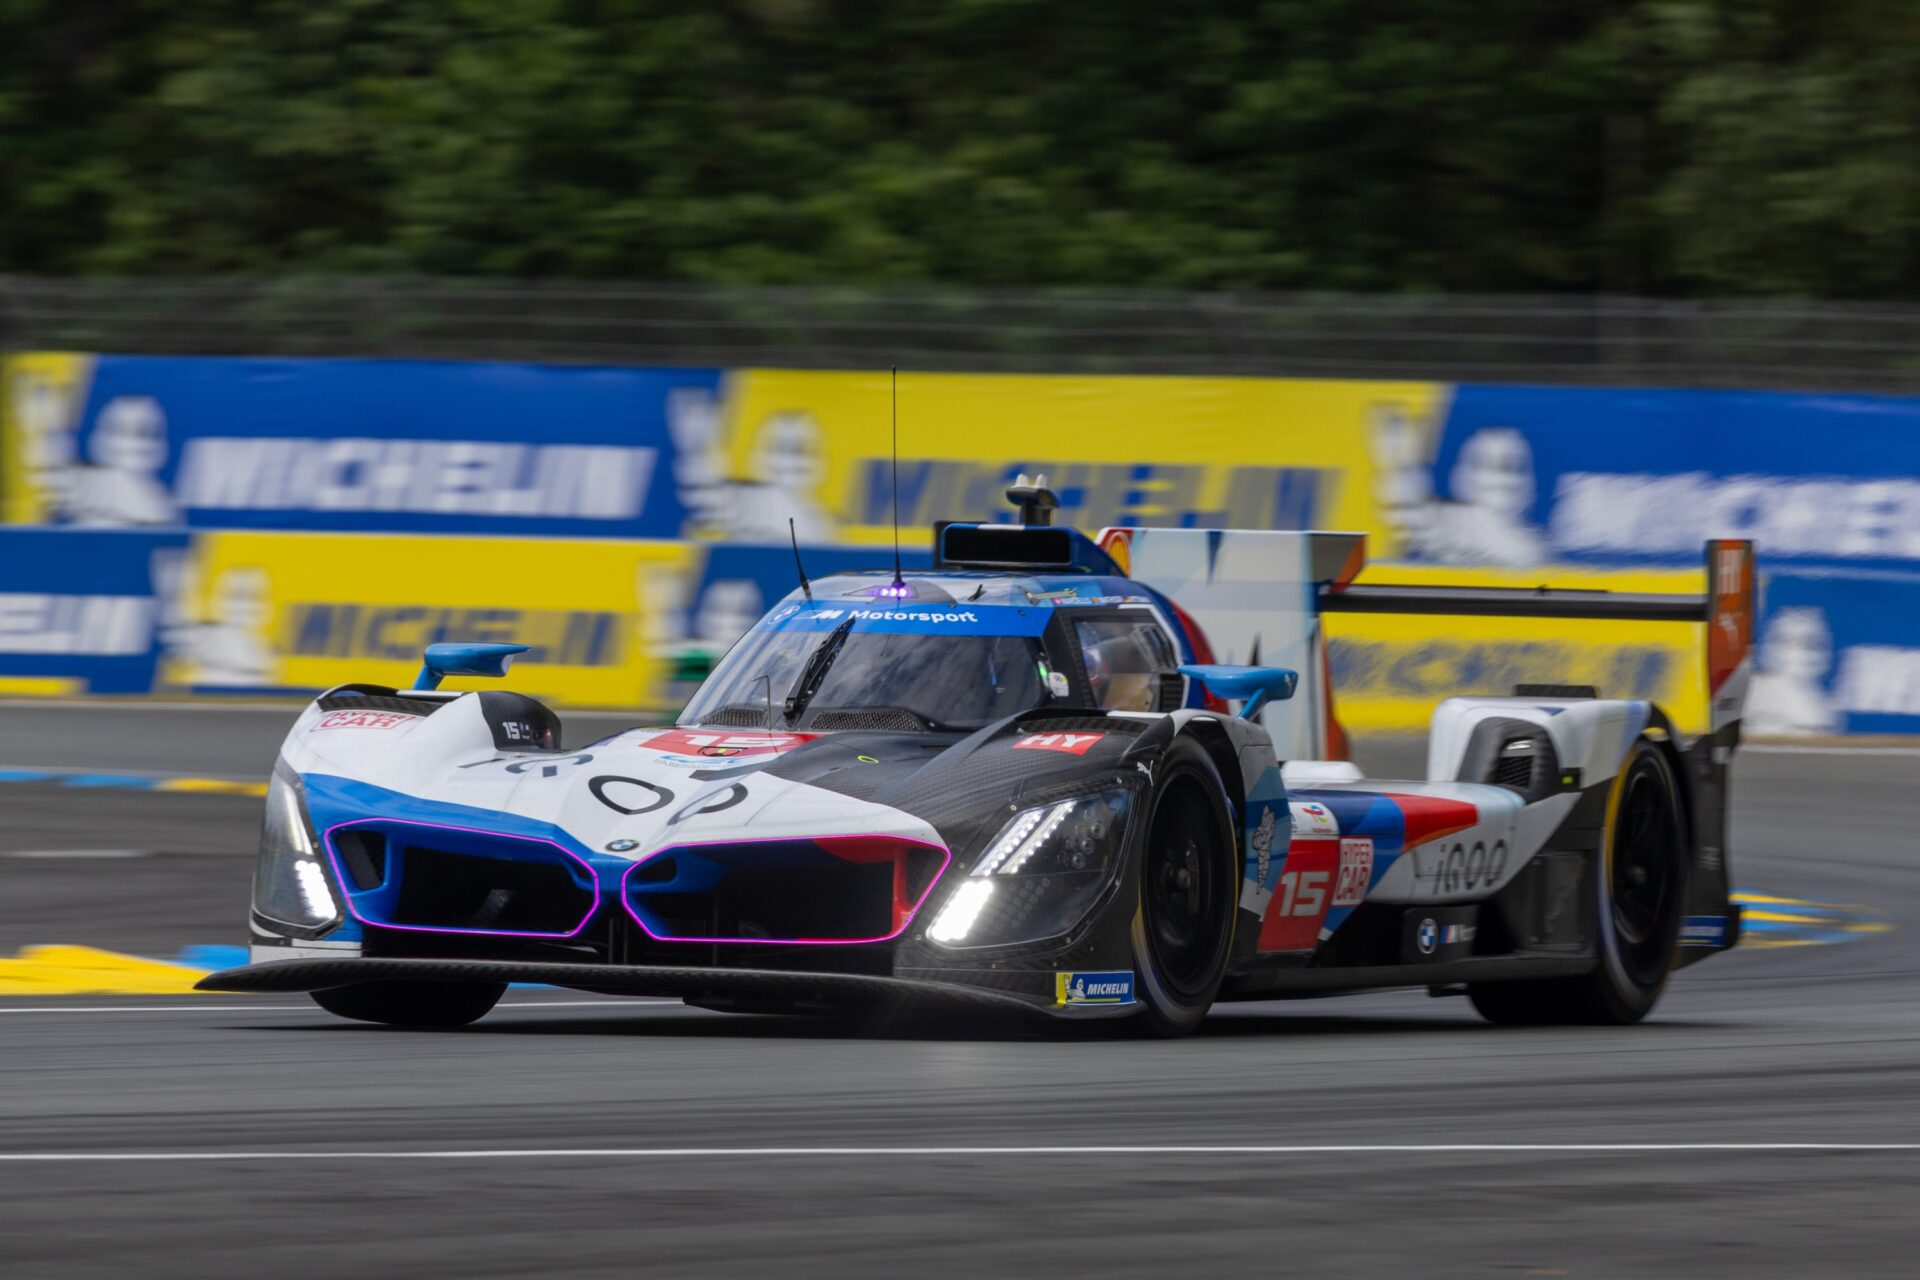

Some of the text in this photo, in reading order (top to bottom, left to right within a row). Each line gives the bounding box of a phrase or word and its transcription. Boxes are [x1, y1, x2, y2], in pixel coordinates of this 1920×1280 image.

[174, 437, 657, 519] MICHELIN
[848, 610, 978, 624] Motorsport
[321, 717, 396, 727] CAR
[502, 721, 520, 739] 15
[685, 735, 794, 747] 15
[1020, 734, 1096, 748] HY
[1336, 865, 1369, 900] CAR
[1281, 871, 1329, 917] 15
[1087, 983, 1129, 995] MICHELIN
